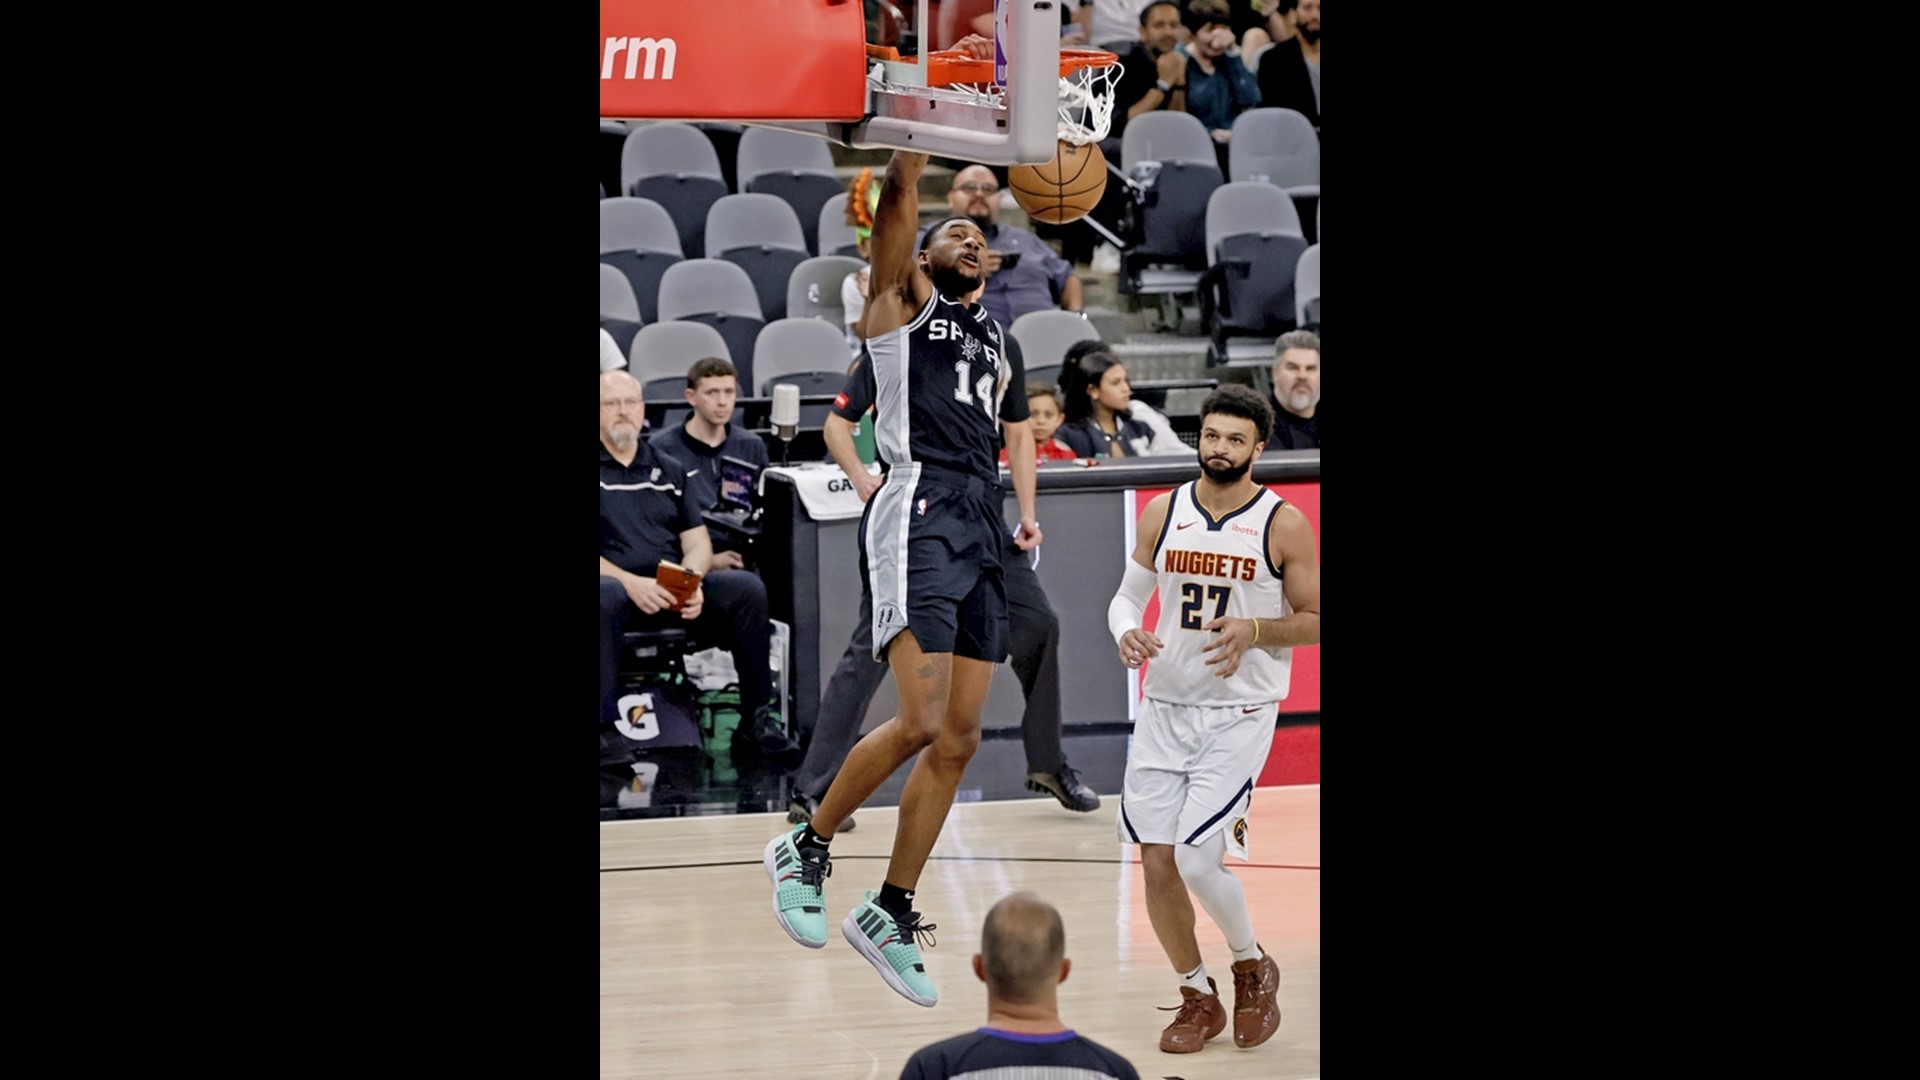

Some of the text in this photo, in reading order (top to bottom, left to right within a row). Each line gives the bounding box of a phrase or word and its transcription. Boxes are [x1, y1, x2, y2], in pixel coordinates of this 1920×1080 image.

[954, 360, 996, 421] 14
[1165, 549, 1257, 582] NUGGETS
[1180, 582, 1233, 633] 27
[614, 692, 661, 741] G
